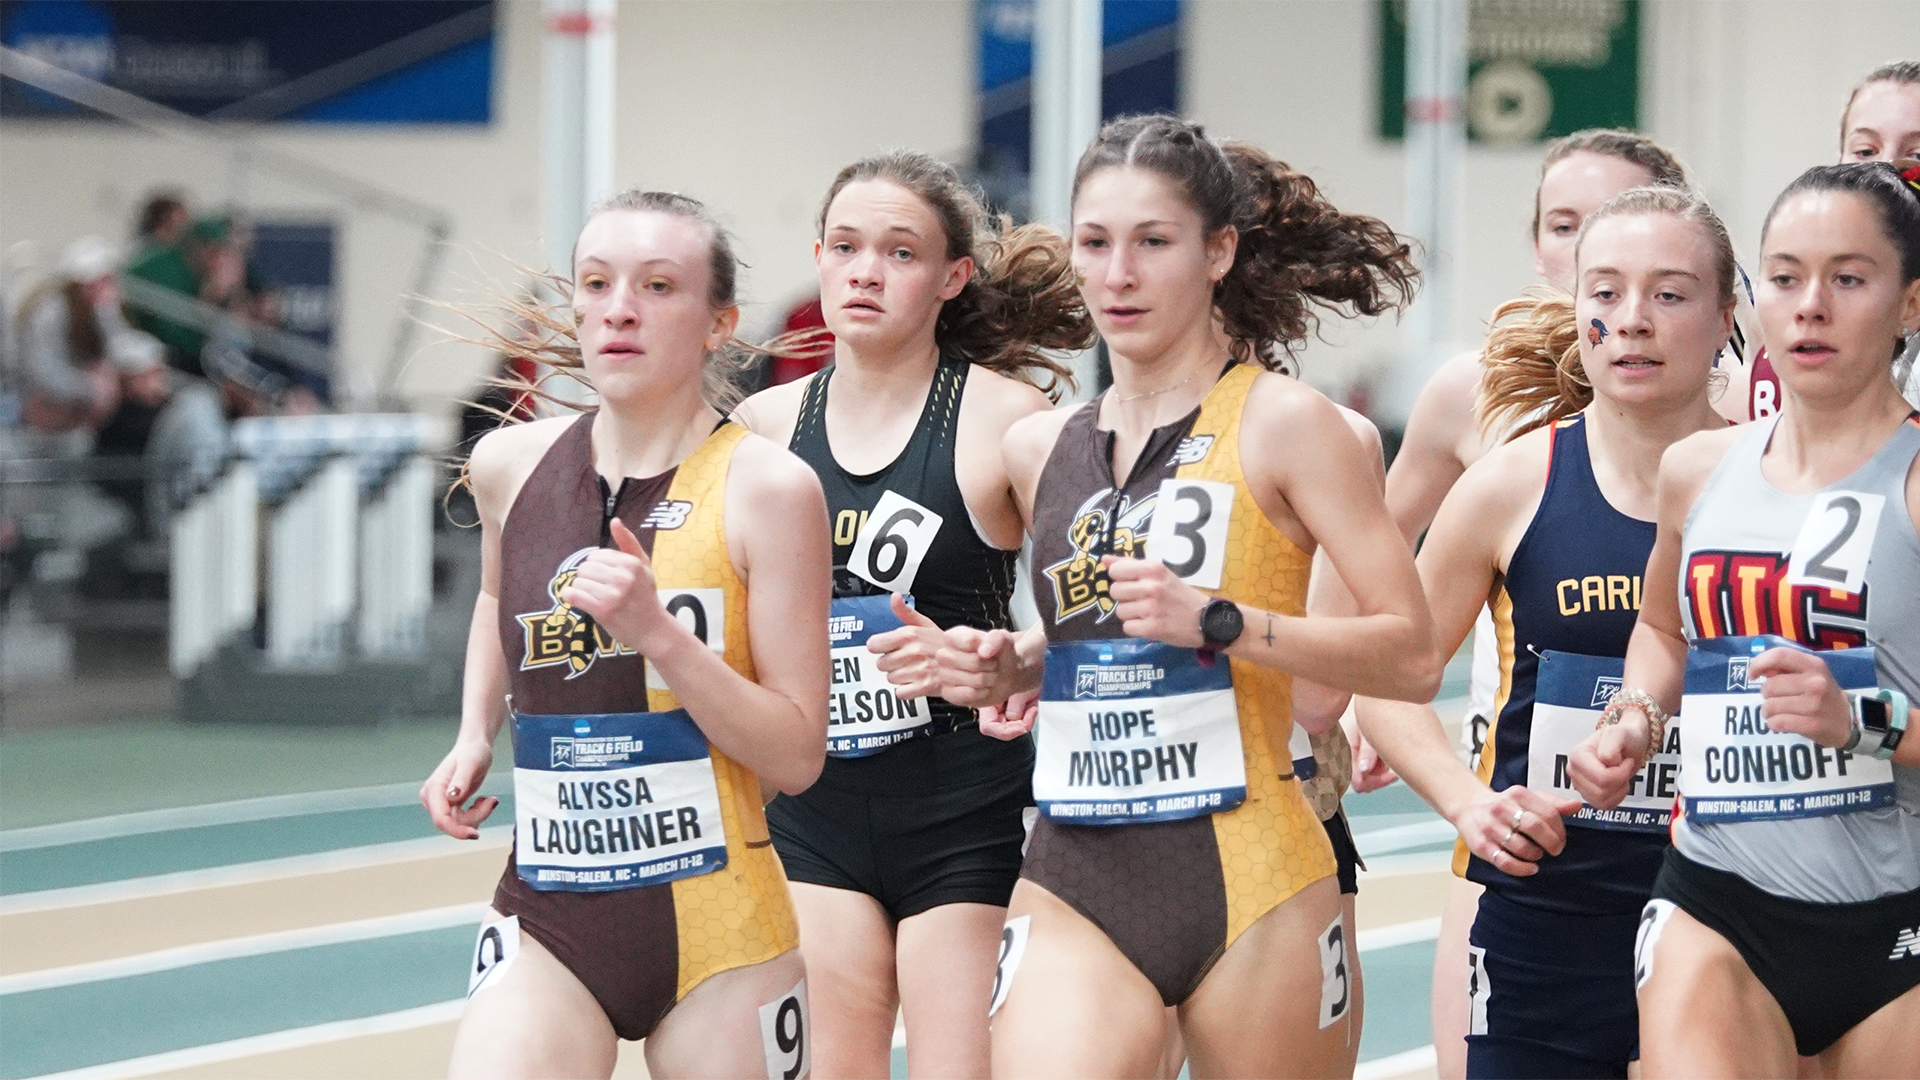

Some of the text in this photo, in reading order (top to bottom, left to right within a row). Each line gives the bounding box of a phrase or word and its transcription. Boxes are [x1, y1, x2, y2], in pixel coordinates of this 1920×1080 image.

[1754, 380, 1779, 418] B
[640, 499, 693, 531] NB
[867, 507, 925, 584] 6
[1162, 485, 1213, 579] 3
[1803, 495, 1862, 583] 2
[1556, 575, 1642, 616] CARL
[840, 620, 864, 632] FIELD
[832, 657, 861, 684] EN
[1098, 671, 1127, 683] TRACK
[1128, 670, 1135, 682] &
[1136, 668, 1165, 681] FIELD
[1098, 681, 1152, 691] CHAMPIONSHIPS
[829, 688, 918, 725] ELSON
[1725, 704, 1784, 735] RAC
[1088, 709, 1156, 741] HOPE
[575, 743, 606, 755] TRACK
[615, 740, 643, 753] FIELD
[838, 739, 851, 751] NC
[858, 736, 892, 749] MARCH
[1068, 742, 1198, 787] MURPHY
[1705, 743, 1853, 783] CONHOFF
[558, 776, 654, 810] ALYSSA
[1050, 793, 1221, 816] WINSTON-SALEM, NC MARCH 11-12
[1696, 790, 1871, 814] WINSTON-SALEM, NC MARCH 11-12
[531, 806, 702, 855] LAUGHNER
[1573, 808, 1632, 824] ON-SALEM,
[1635, 812, 1651, 824] NC
[615, 869, 631, 881] NC
[639, 858, 678, 878] MARCH
[680, 854, 704, 870] 11-12
[1889, 926, 1920, 959] N
[1328, 924, 1348, 1018] 3
[775, 995, 805, 1080] 9
